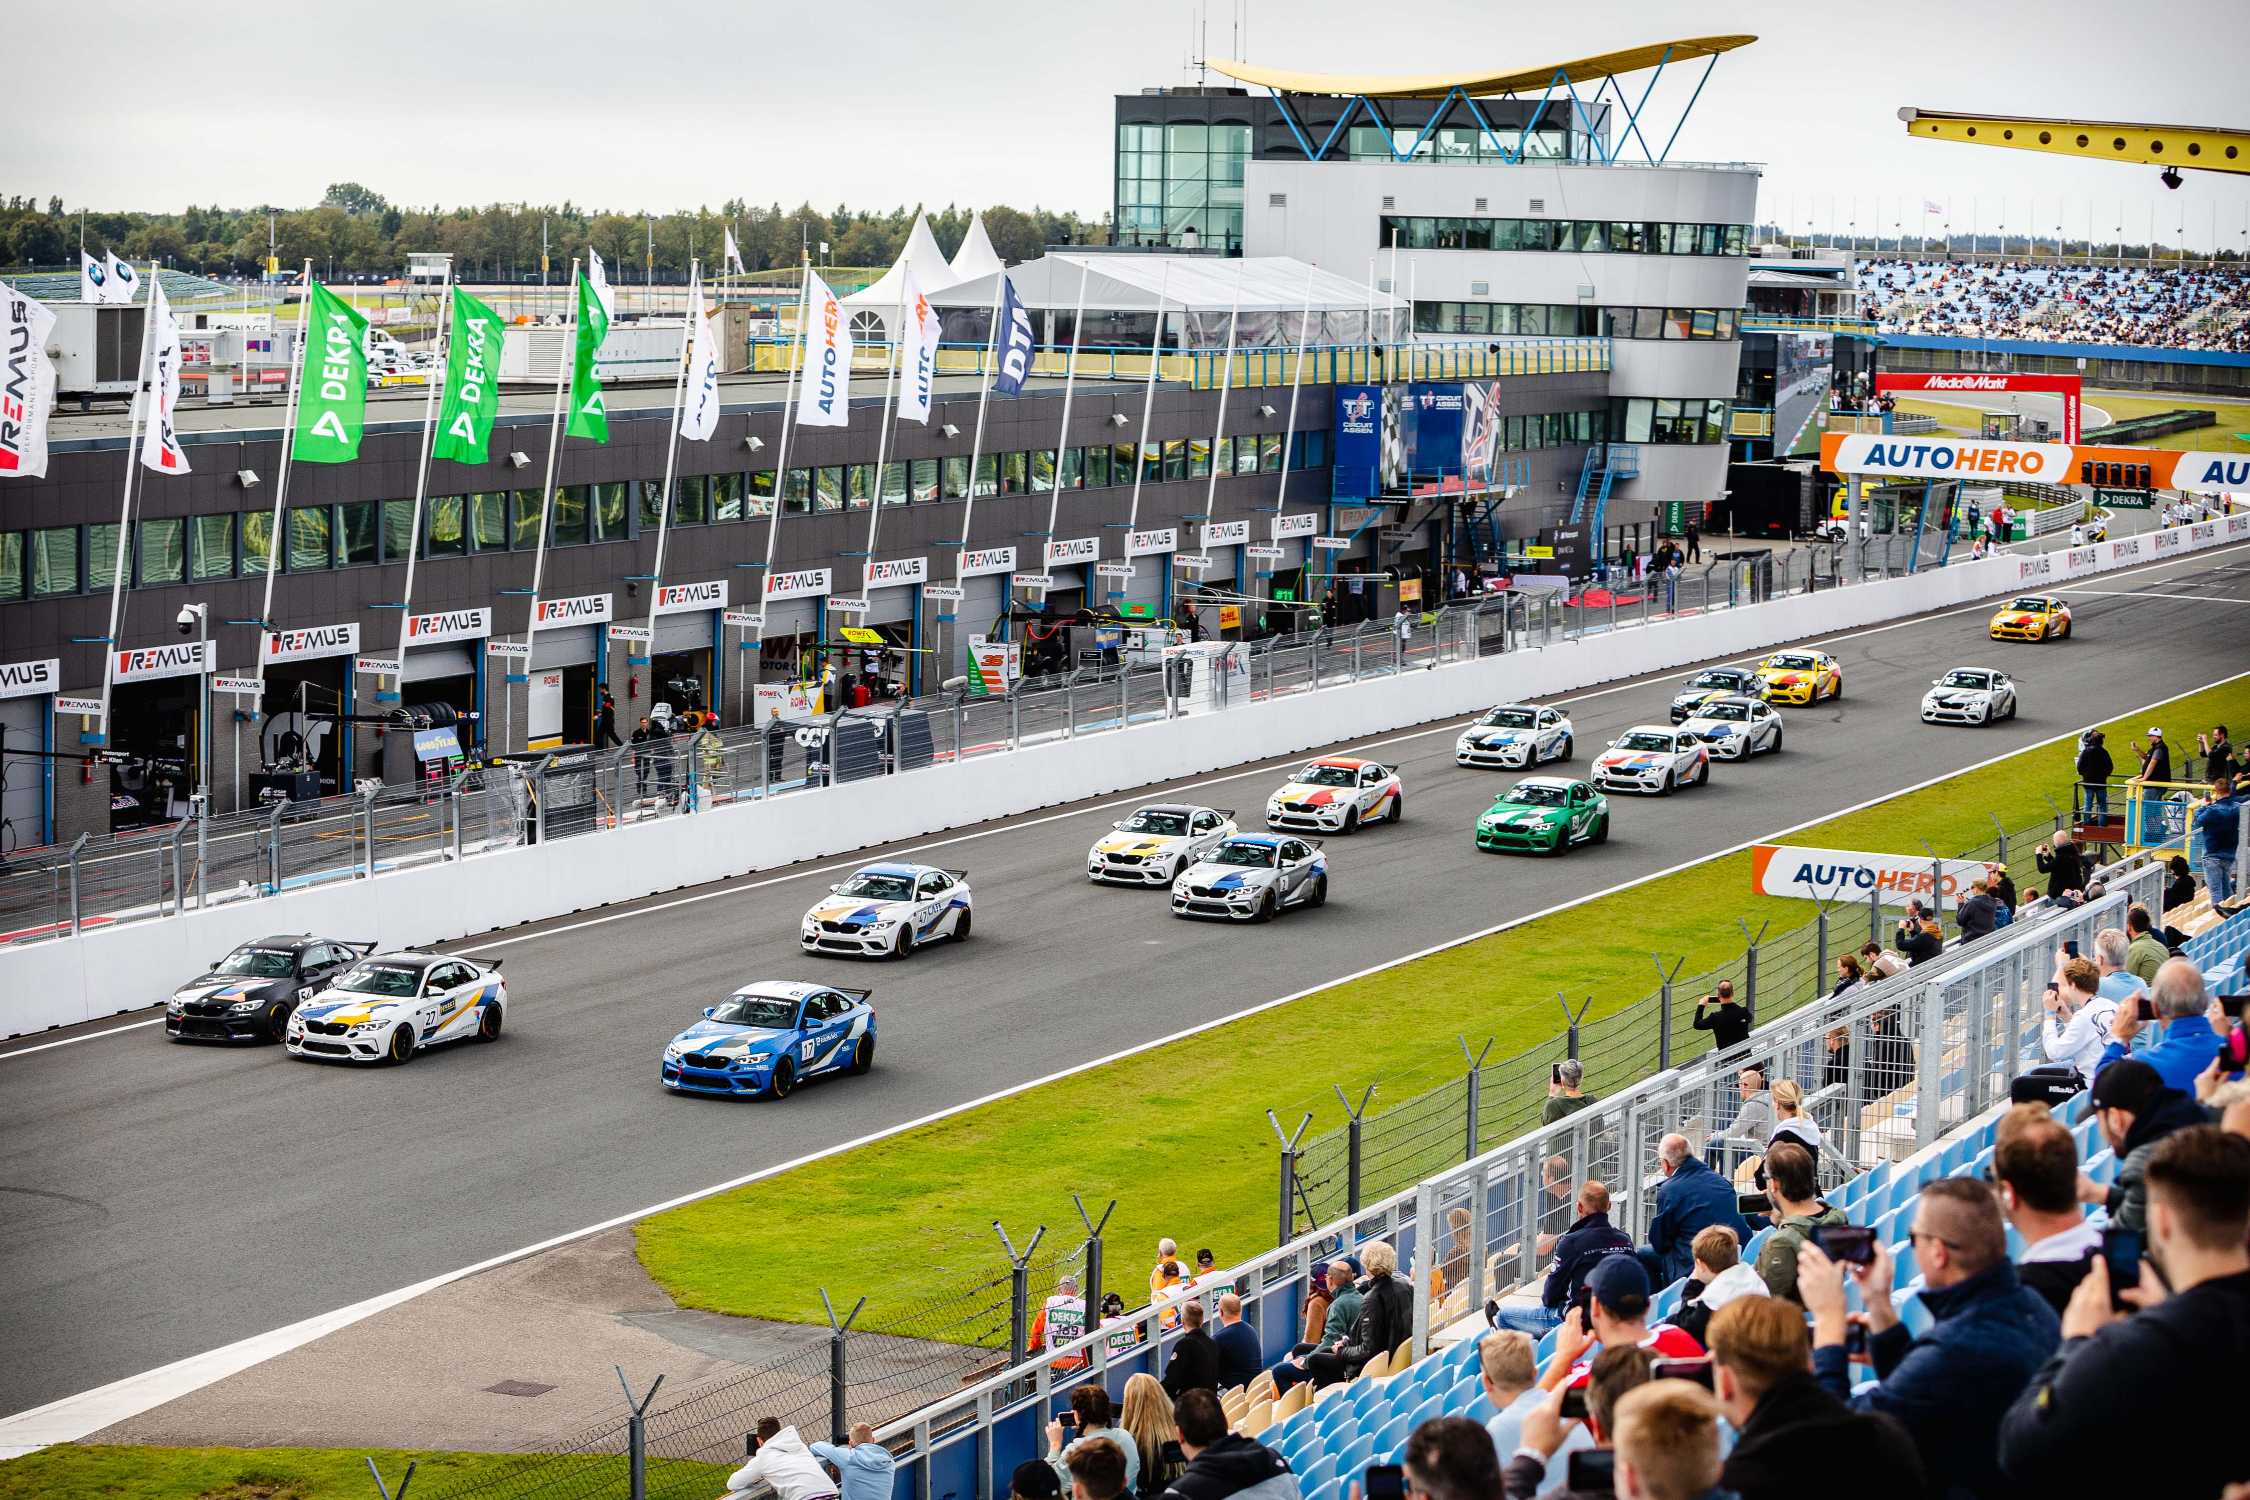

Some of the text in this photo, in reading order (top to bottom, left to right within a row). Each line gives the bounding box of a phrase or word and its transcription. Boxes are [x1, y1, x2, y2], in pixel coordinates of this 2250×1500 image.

[460, 318, 489, 404] DEKRA
[1863, 442, 2045, 475] AUTOHERO
[2111, 495, 2144, 506] DEKRA
[1208, 523, 1244, 539] REMUS
[1279, 516, 1313, 531] REMUS
[1133, 531, 1172, 548] REMUS
[1052, 540, 1094, 558] REMUS
[966, 549, 1011, 569] REMUS
[874, 560, 921, 581] REMUS
[773, 571, 824, 593] REMUS
[665, 583, 720, 604] REMUS
[931, 588, 961, 596] REMUS
[545, 597, 605, 620] REMUS
[834, 599, 867, 609] REMUS
[417, 611, 482, 635] REMUS
[730, 614, 763, 624] REMUS
[281, 626, 350, 651] REMUS
[615, 628, 650, 637] REMUS
[494, 644, 529, 652] REMUS
[130, 645, 203, 673] REMUS
[363, 661, 400, 670] REMUS
[0, 663, 48, 689] MUS
[221, 679, 261, 689] REMUS
[64, 700, 101, 710] REMUS
[1792, 862, 1959, 897] AUTOHERO
[425, 1010, 436, 1026] 27
[803, 1042, 814, 1058] 17
[1051, 1312, 1084, 1323] DEKRA
[1110, 1334, 1135, 1346] DEKRA
